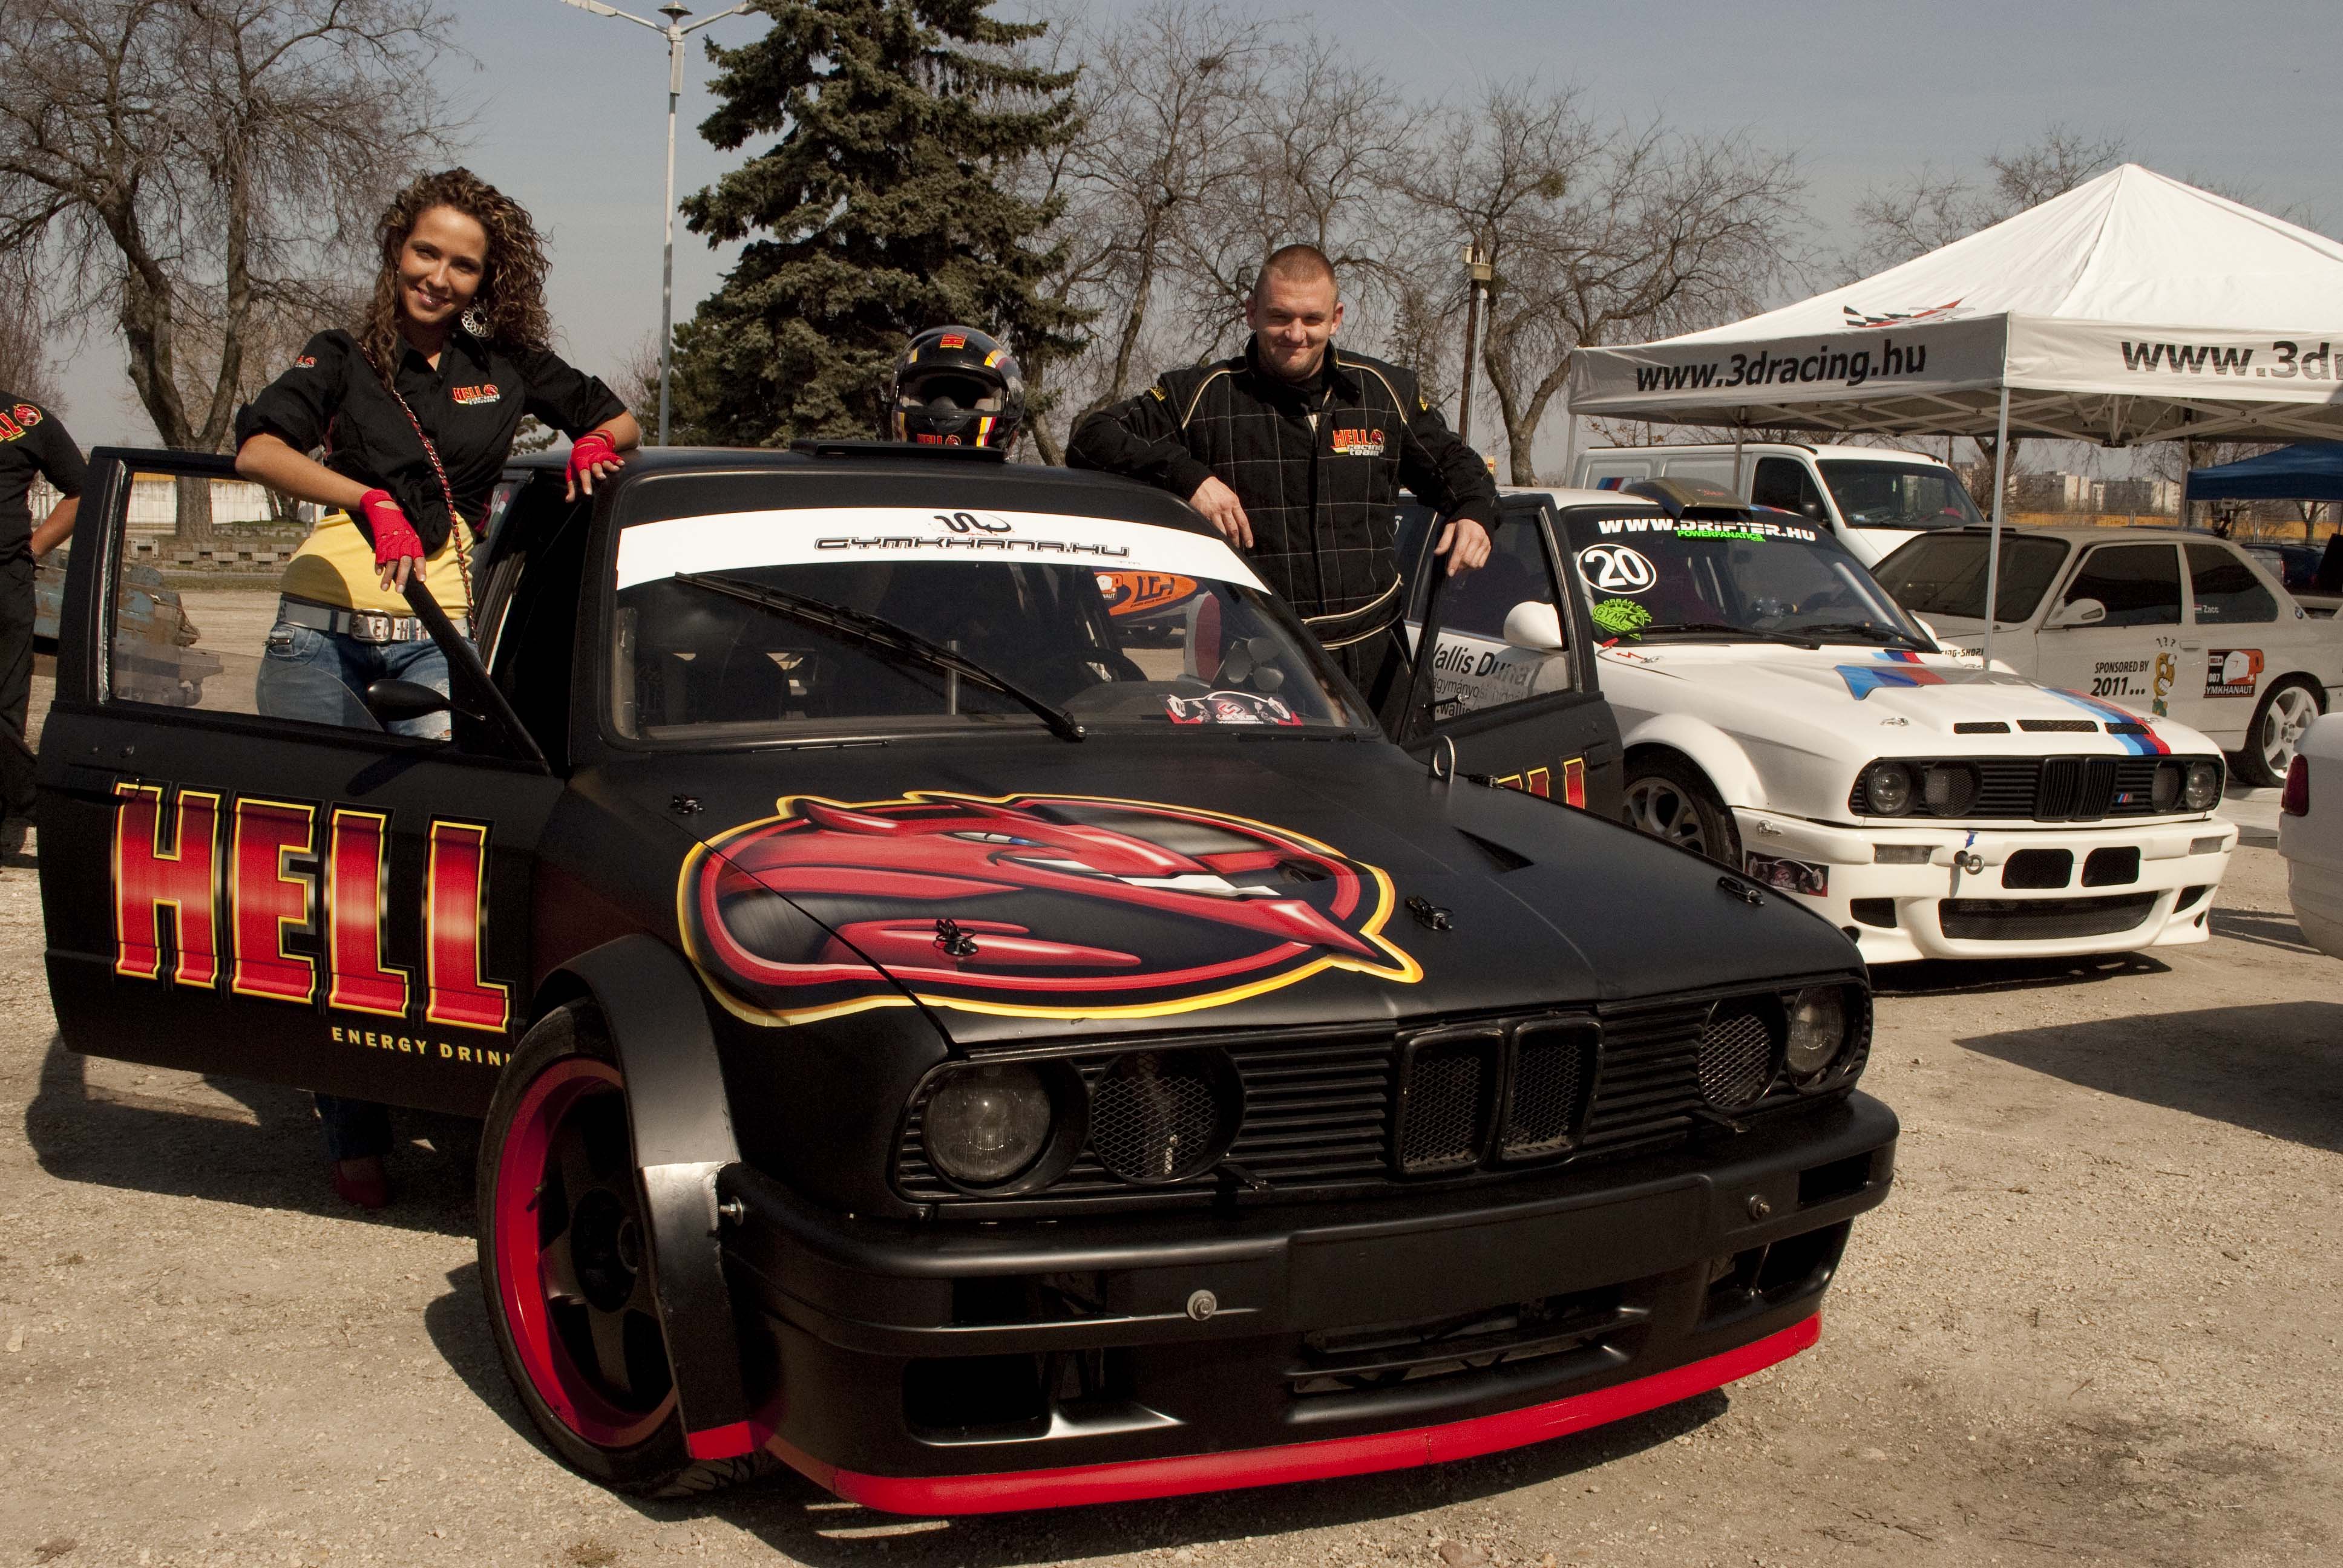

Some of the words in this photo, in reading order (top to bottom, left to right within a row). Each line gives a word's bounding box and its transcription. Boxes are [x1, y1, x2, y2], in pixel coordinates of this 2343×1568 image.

[1636, 339, 1927, 392] www.3dracing.hu
[453, 385, 483, 400] HELL
[1332, 429, 1369, 447] HELL
[1598, 518, 1816, 541] WWW.DRIFTER.HU
[1677, 530, 1763, 540] POWERFANATICS
[1585, 549, 1649, 587] 20
[1434, 643, 1475, 675] allis
[2094, 661, 2138, 674] SPONSORED
[2139, 660, 2149, 672] BY
[115, 782, 509, 1033] HELL
[331, 1026, 428, 1056] ENERGY
[439, 1042, 511, 1067] DRIN
